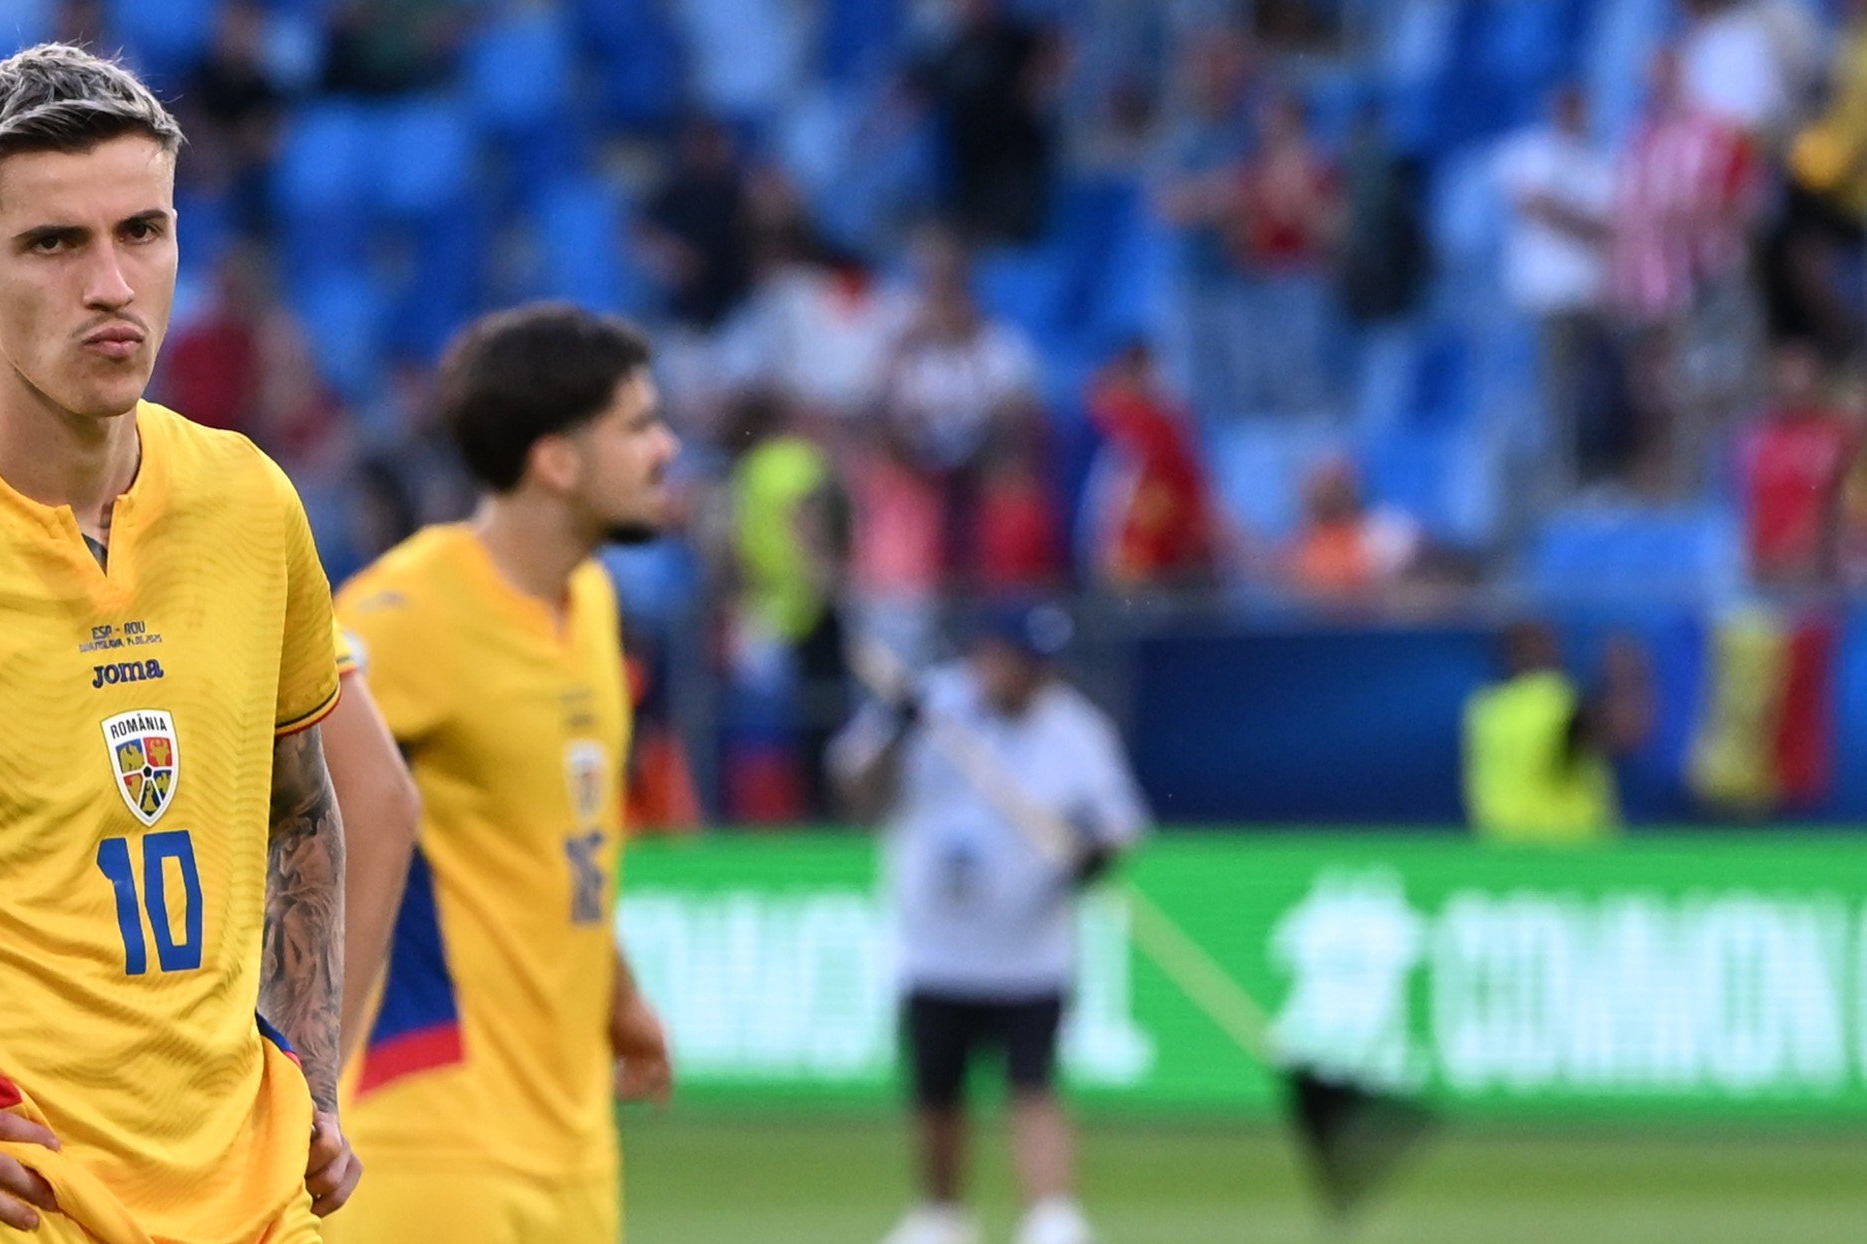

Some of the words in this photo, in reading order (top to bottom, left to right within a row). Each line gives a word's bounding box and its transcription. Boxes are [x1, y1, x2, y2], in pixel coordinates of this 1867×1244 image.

[91, 625, 112, 640] ESP
[110, 713, 168, 739] ROMÂNIA
[96, 829, 203, 976] 10
